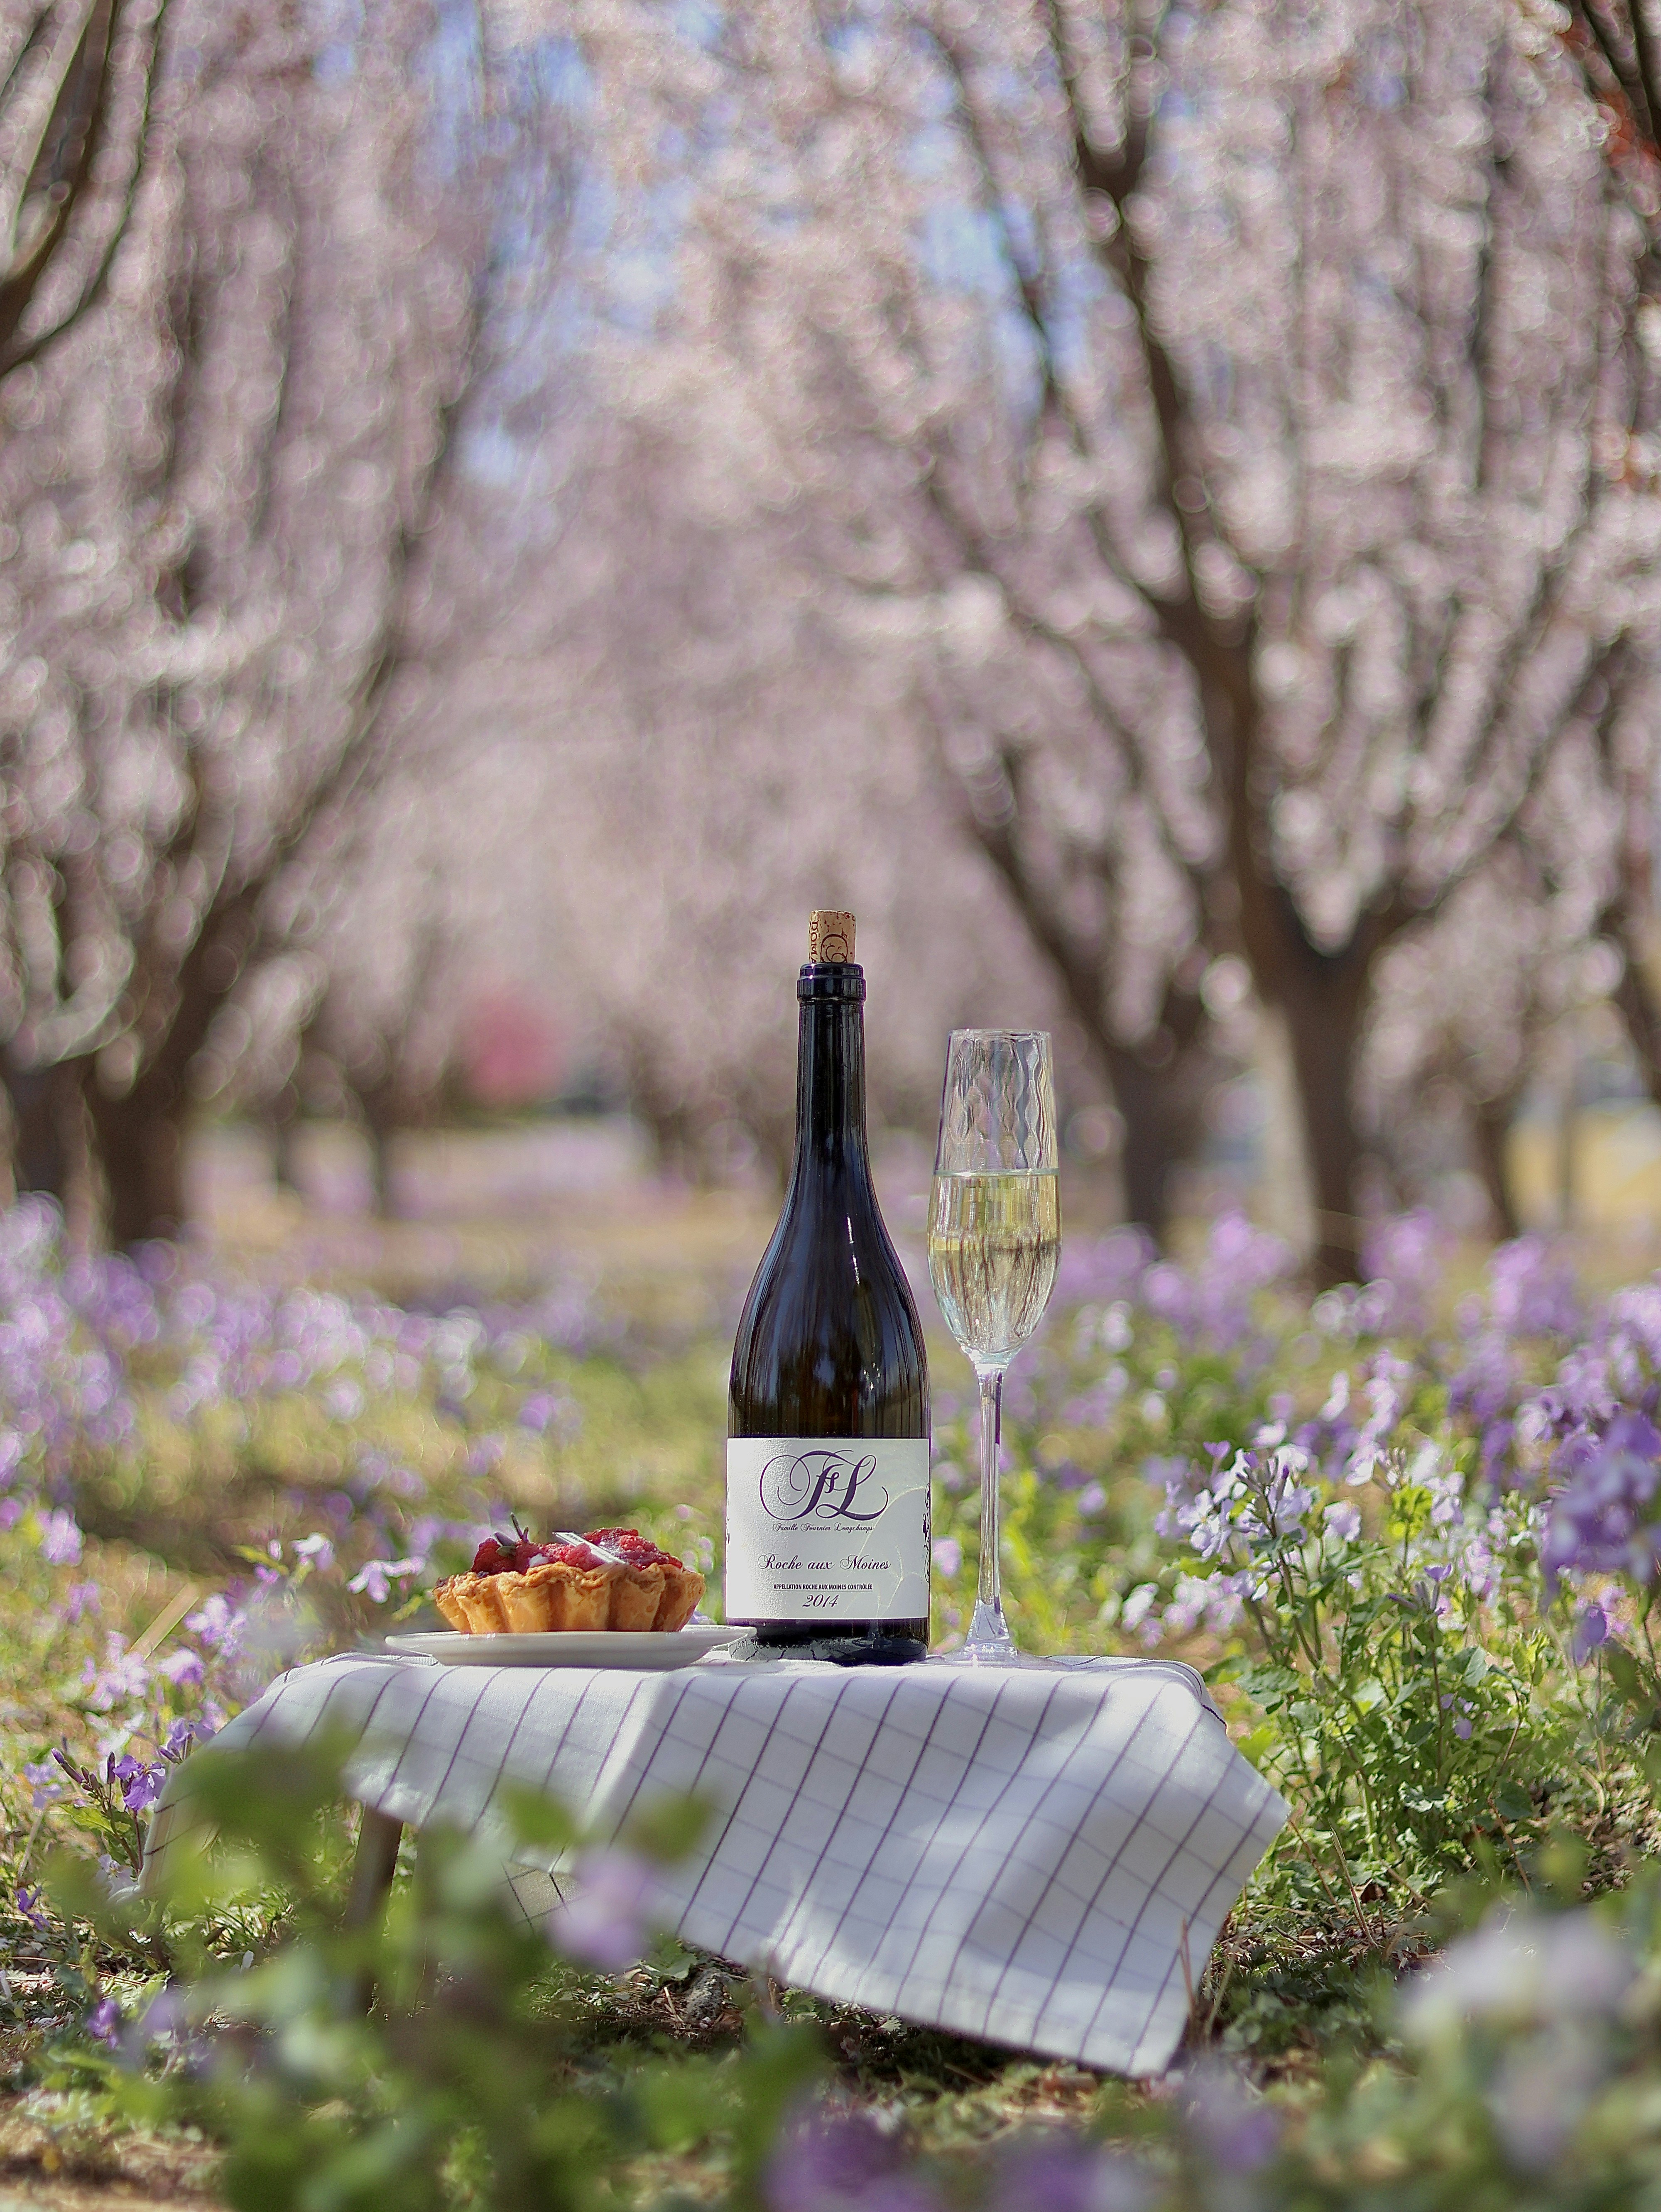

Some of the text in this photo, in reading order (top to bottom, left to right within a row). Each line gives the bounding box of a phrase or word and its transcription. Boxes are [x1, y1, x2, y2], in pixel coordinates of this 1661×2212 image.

[772, 1522, 872, 1534] Famille Fournier Longchamps
[757, 1553, 891, 1570] Roche aux Moines
[802, 1594, 839, 1608] 2014
